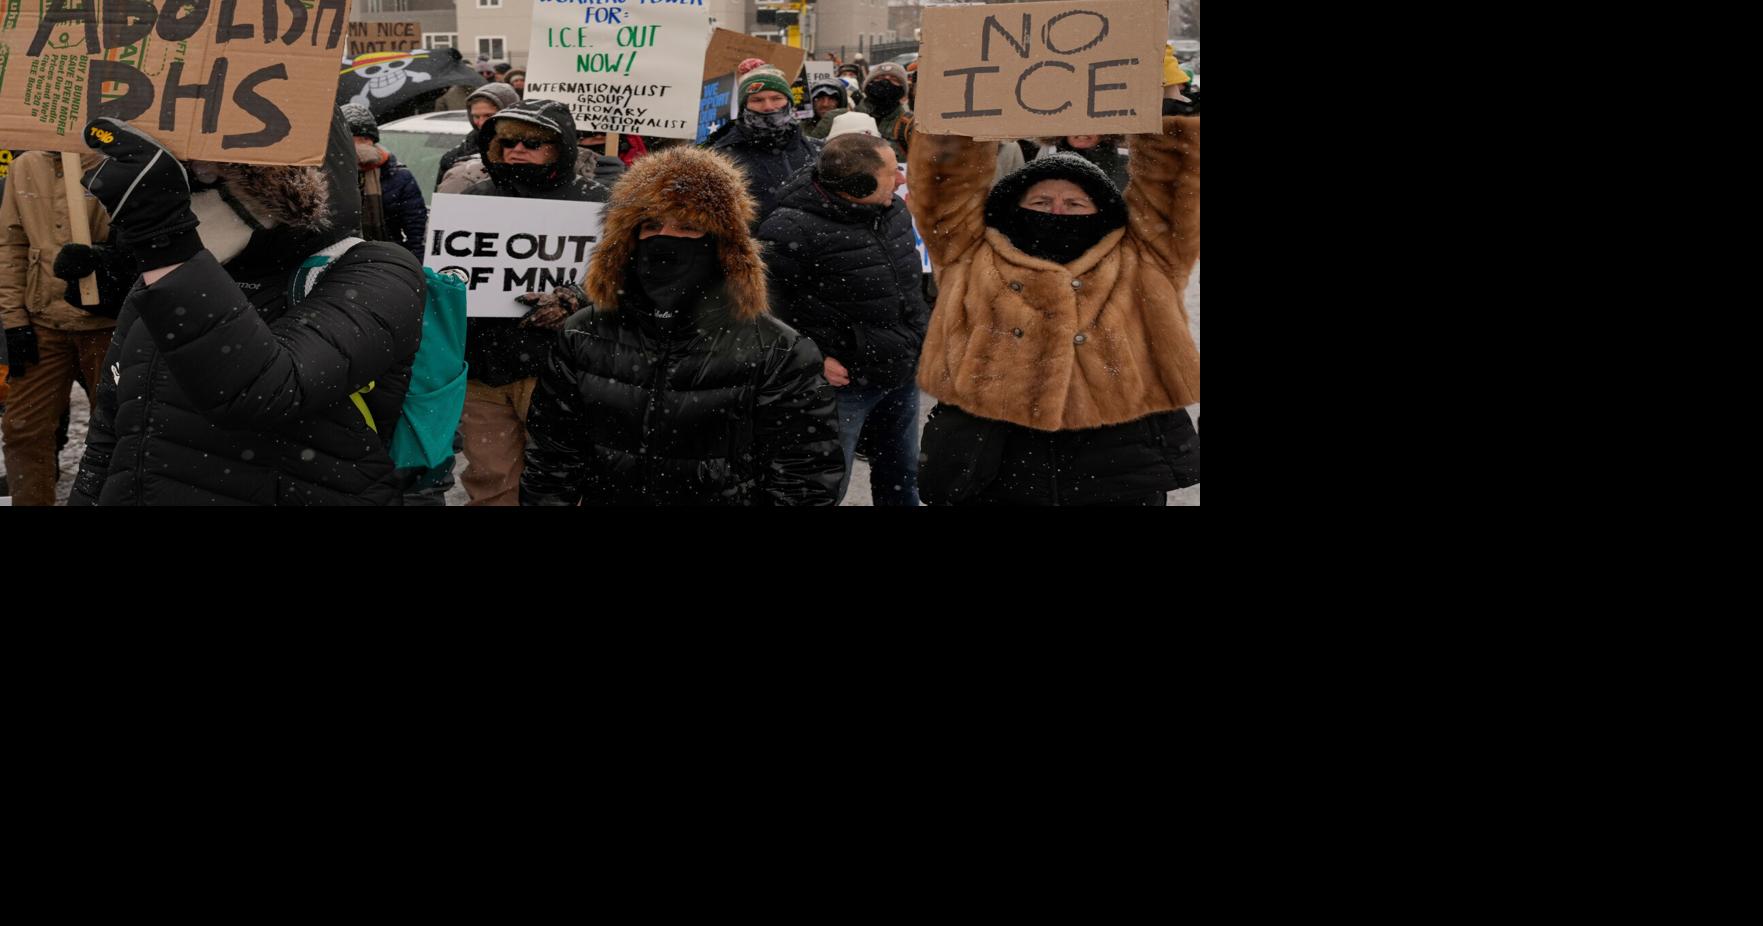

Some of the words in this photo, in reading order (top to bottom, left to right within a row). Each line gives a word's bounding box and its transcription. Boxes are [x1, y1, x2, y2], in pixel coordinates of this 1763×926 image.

[585, 7, 629, 24] FOR:
[348, 22, 368, 37] MN
[377, 22, 415, 37] NICE
[549, 26, 594, 48] I.C.E.
[616, 24, 662, 48] OUT
[981, 9, 1109, 61] NO
[30, 59, 39, 75] REE
[47, 54, 58, 80] Prices
[66, 55, 78, 78] SAVE
[78, 55, 89, 74] BUY
[576, 51, 637, 77] NOW!
[36, 75, 45, 90] You
[55, 75, 63, 91] Our
[62, 80, 73, 104] EVEN
[527, 82, 672, 97] INTERNATIONALIST
[941, 58, 1139, 119] ICE
[31, 108, 38, 117] in
[86, 57, 292, 149] DHS
[570, 103, 648, 117] UTIONARY
[56, 106, 68, 137] MORE!
[591, 121, 640, 134] YOUTH
[431, 230, 499, 257] ICE
[505, 233, 596, 263] OUT
